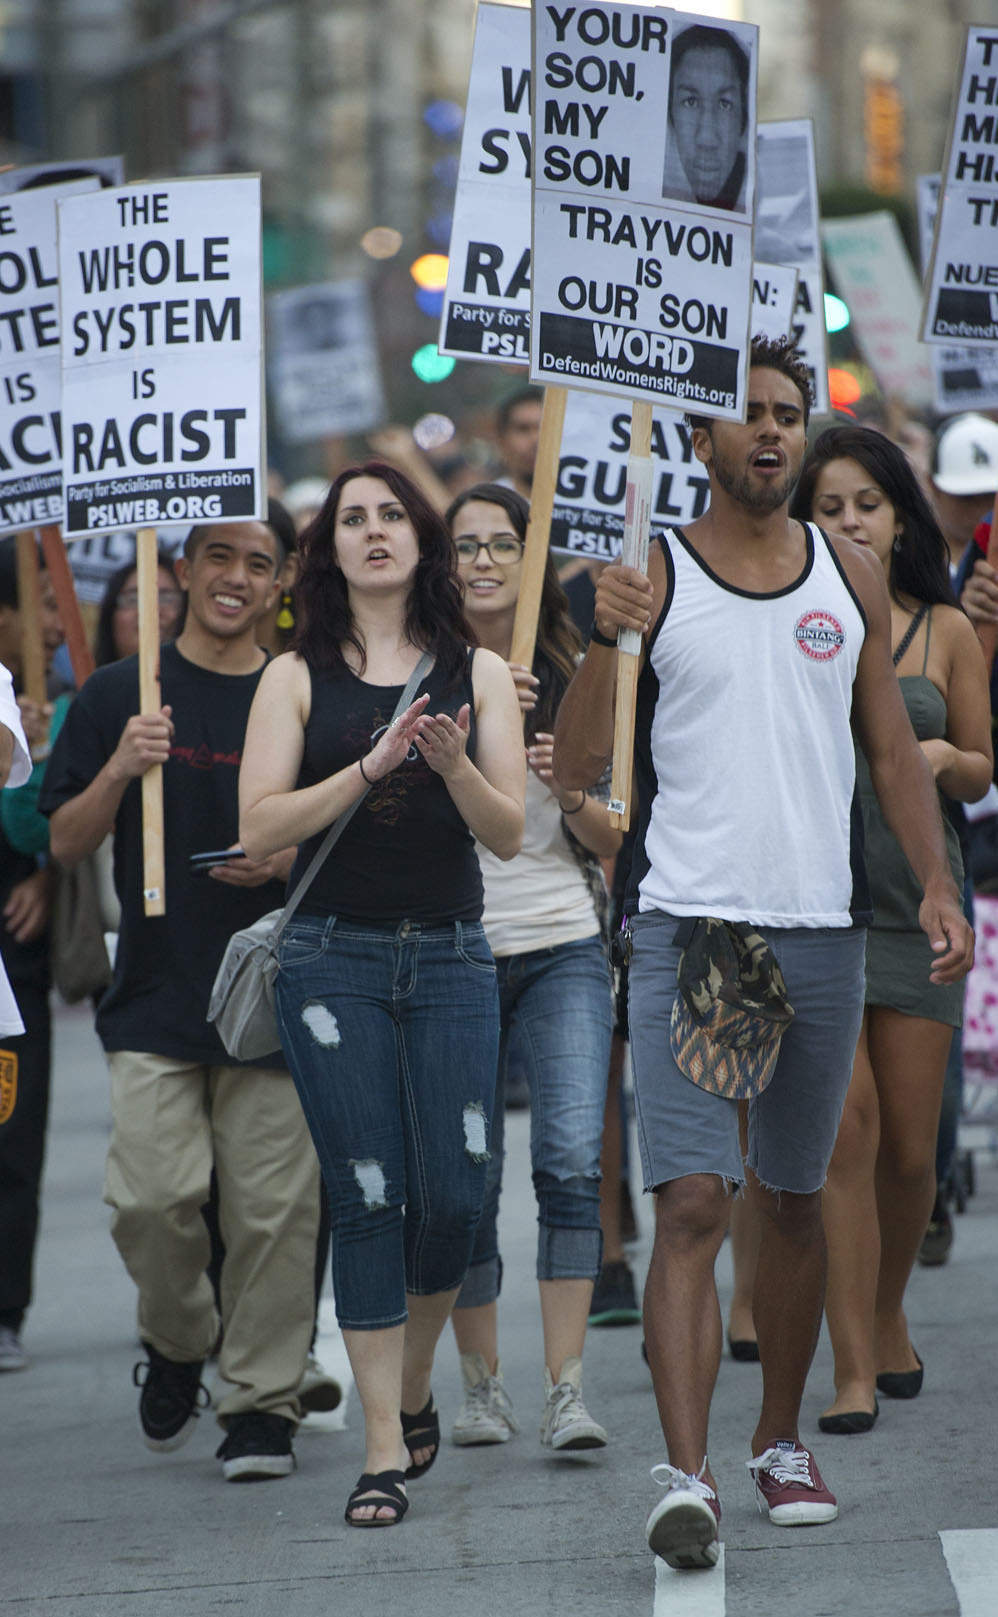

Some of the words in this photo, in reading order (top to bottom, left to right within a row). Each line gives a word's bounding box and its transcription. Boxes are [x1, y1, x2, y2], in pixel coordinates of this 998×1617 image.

[545, 5, 668, 54] YOUR
[545, 51, 645, 102] SON,
[544, 99, 609, 139] MY
[543, 145, 630, 191] SON
[955, 152, 998, 182] HI
[117, 194, 169, 227] THE
[560, 203, 733, 267] TRAYVON
[79, 237, 230, 294] WHOLE
[636, 257, 663, 288] IS
[73, 297, 241, 357] SYSTEM
[453, 303, 495, 328] Party
[498, 309, 521, 327] for
[557, 275, 639, 321] OUR
[659, 293, 728, 340] SON
[936, 319, 998, 339] Defend
[593, 322, 695, 375] WORD
[5, 373, 36, 404] IS
[133, 369, 156, 400] IS
[542, 352, 735, 409] DefendWomensRights.org
[73, 408, 247, 475] RACIST
[68, 487, 94, 503] Party
[95, 483, 110, 498] for
[111, 475, 162, 496] Socialism
[164, 475, 176, 489] &
[178, 471, 251, 489] Liberation
[556, 456, 711, 518] GULT
[87, 494, 222, 528] PSLWEB.ORG
